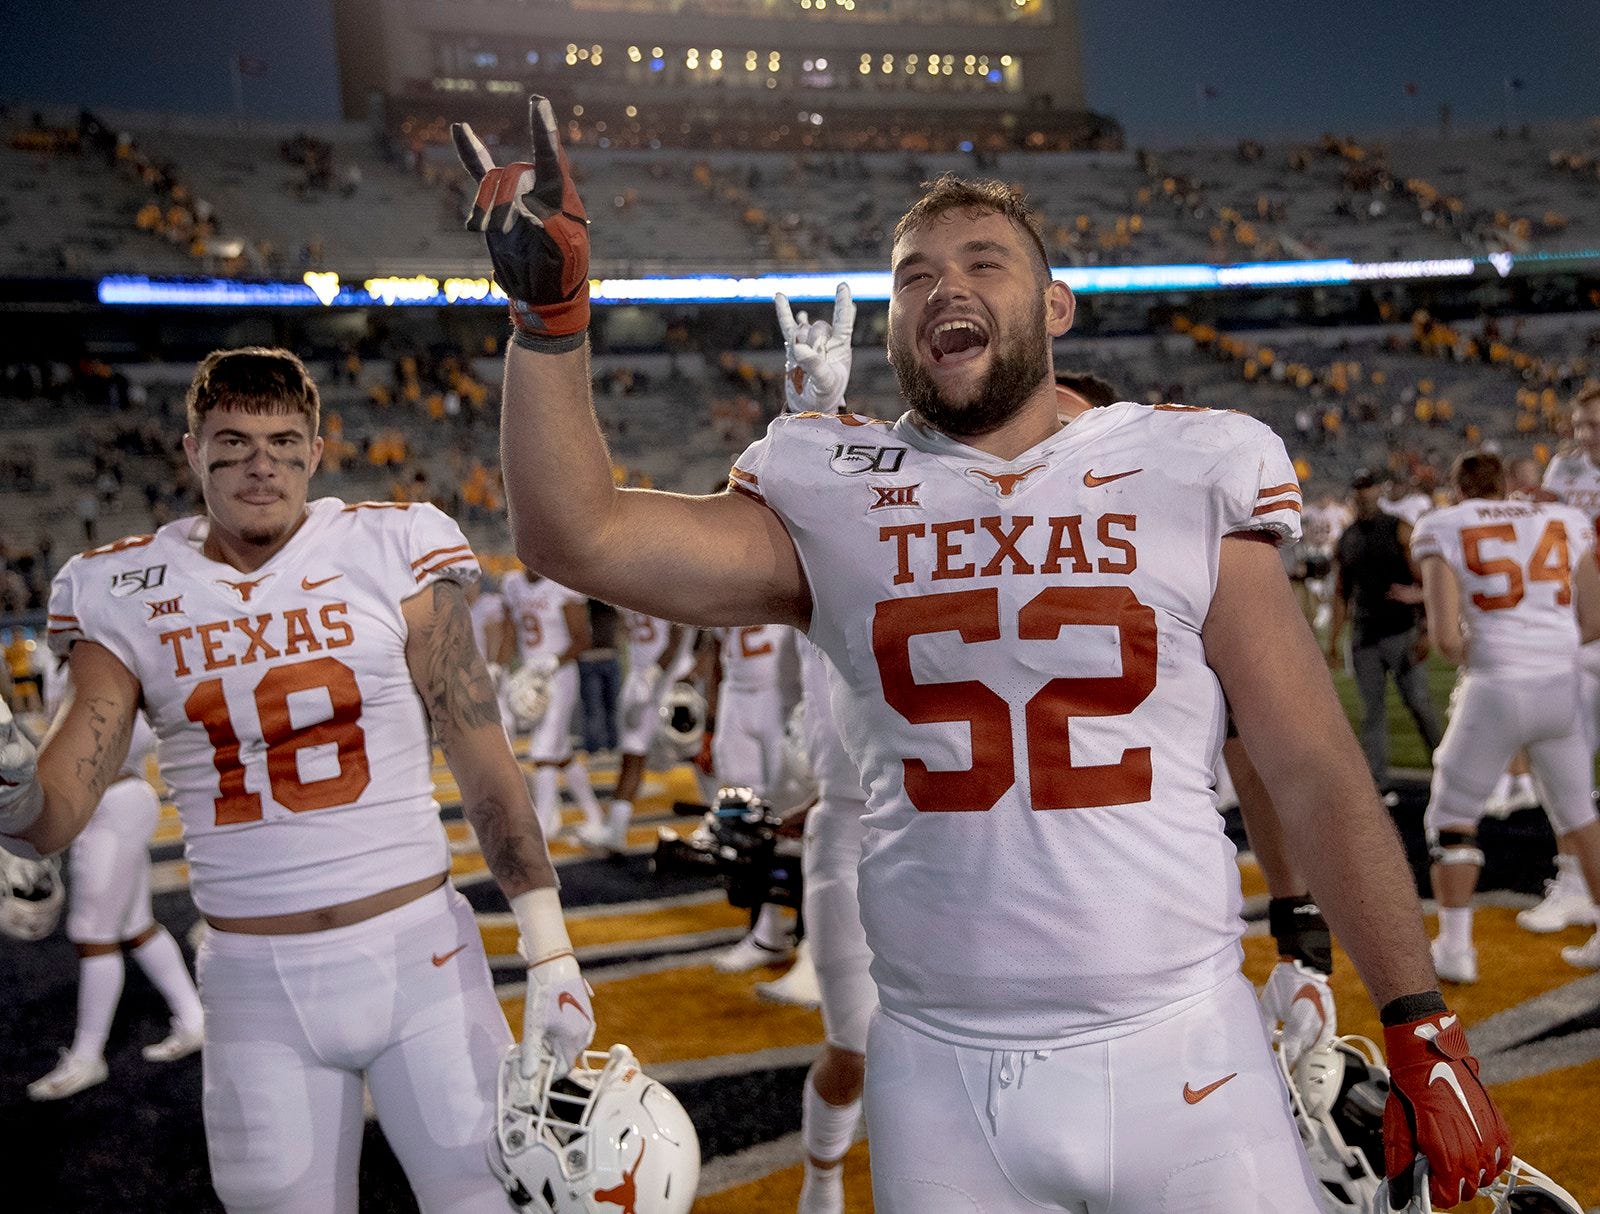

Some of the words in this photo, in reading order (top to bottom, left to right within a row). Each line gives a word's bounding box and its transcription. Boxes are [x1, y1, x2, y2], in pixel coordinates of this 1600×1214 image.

[829, 444, 907, 475] 150
[868, 483, 921, 509] XII
[111, 564, 167, 596] 150
[879, 513, 1137, 585] TEXAS
[1460, 519, 1572, 612] 54
[160, 603, 355, 678] TEXAS
[872, 585, 1158, 812] 52
[184, 656, 371, 826] 18
